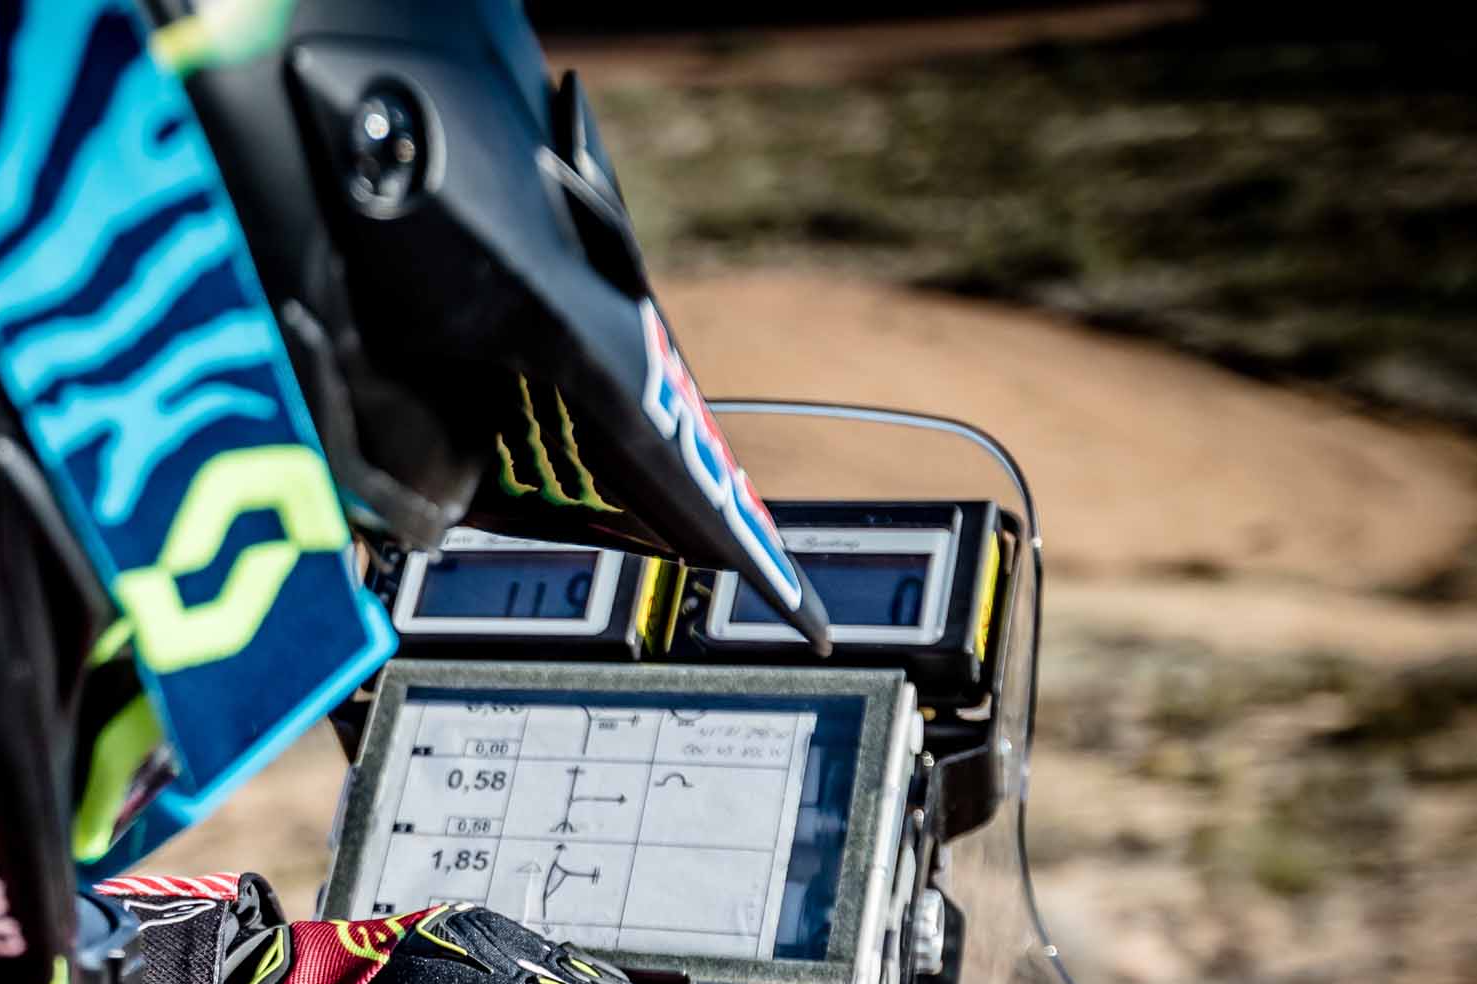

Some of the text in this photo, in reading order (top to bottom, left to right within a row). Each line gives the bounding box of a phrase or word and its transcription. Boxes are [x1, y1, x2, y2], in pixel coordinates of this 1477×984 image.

[475, 742, 509, 757] 0,00
[447, 768, 507, 795] 0,58
[431, 849, 490, 875] 1,85
